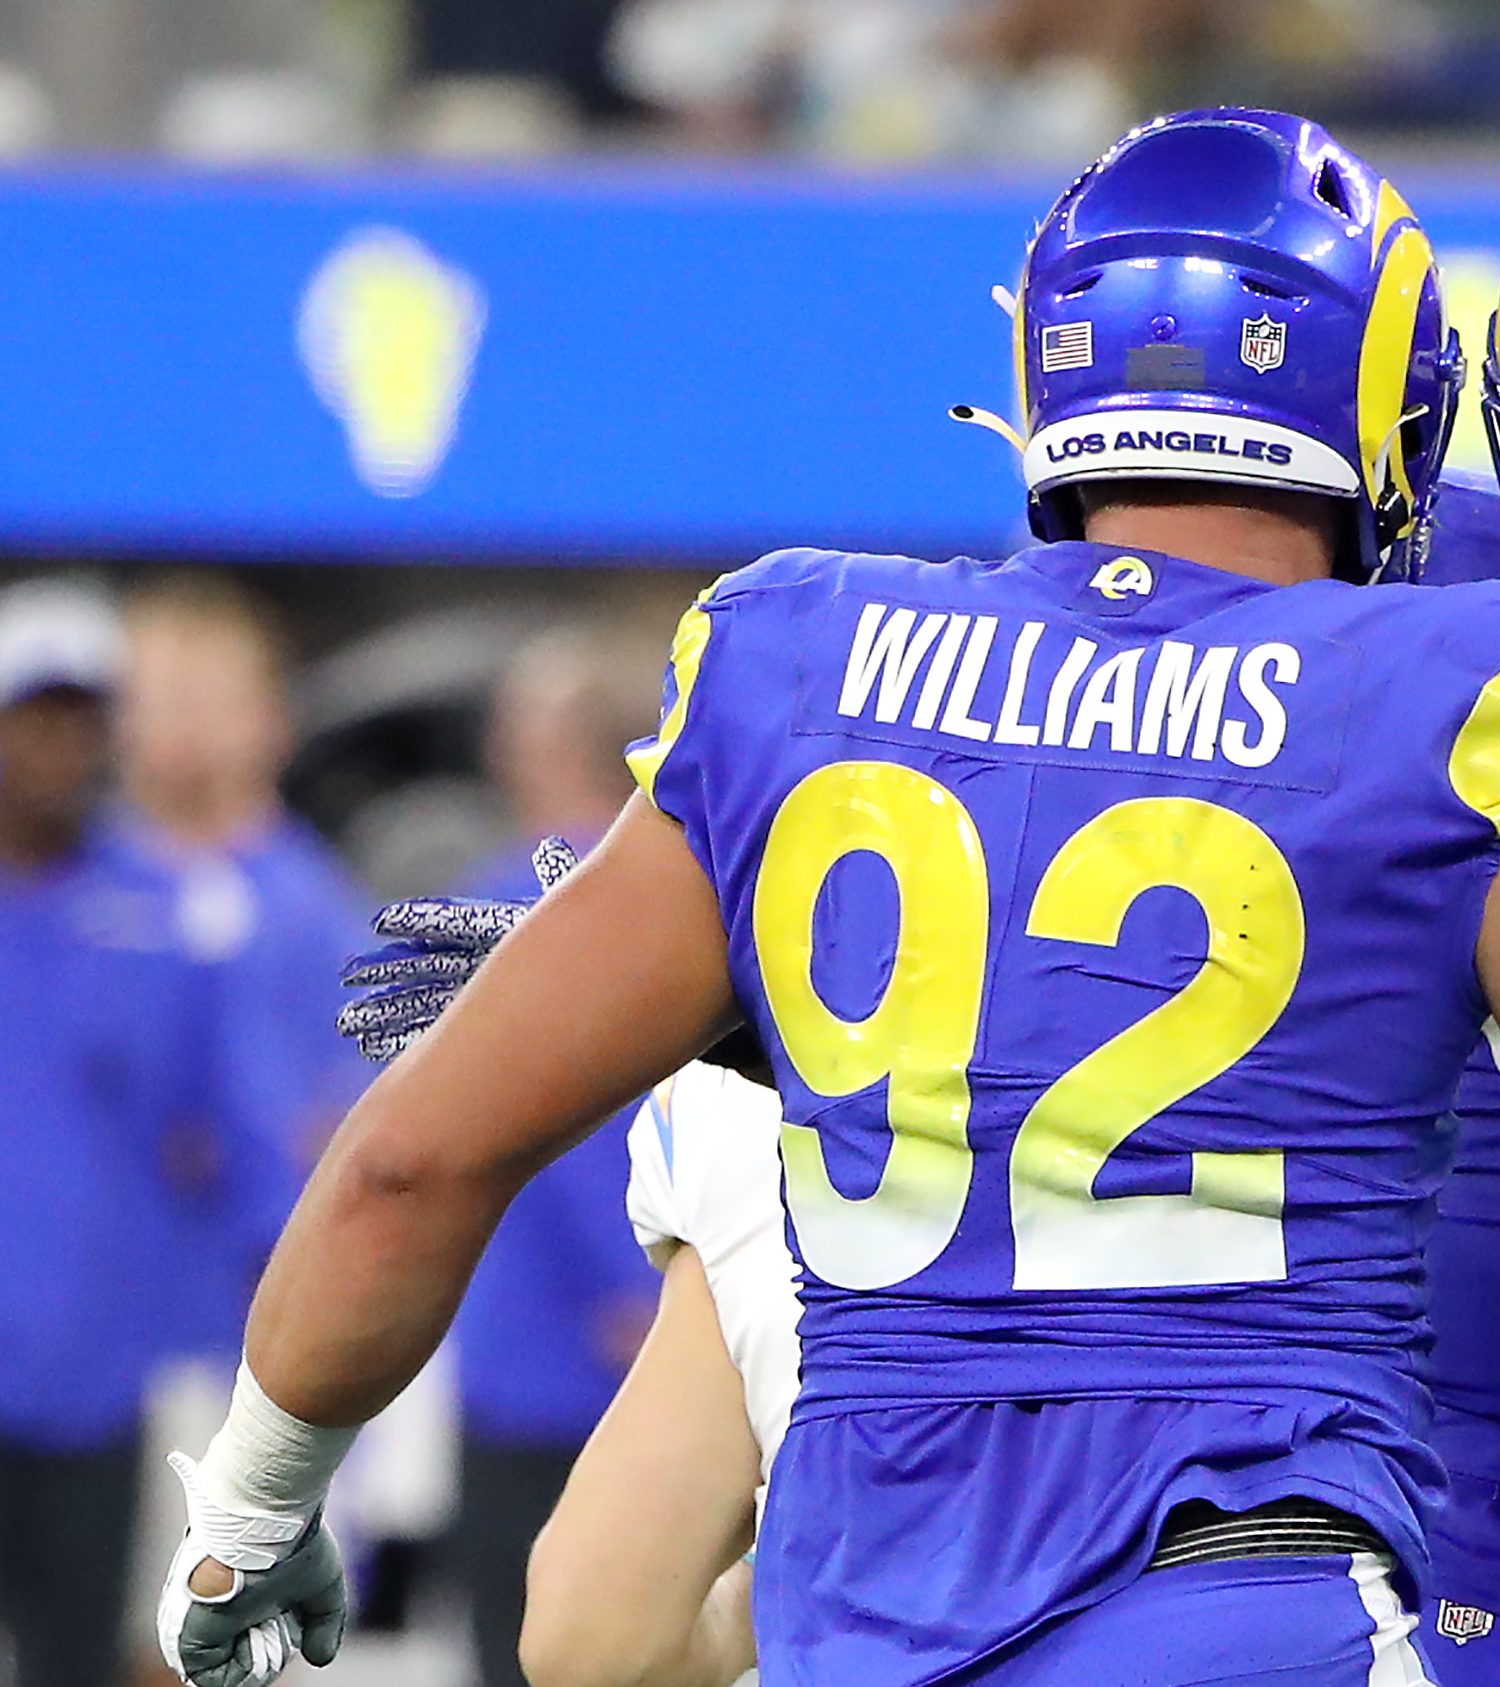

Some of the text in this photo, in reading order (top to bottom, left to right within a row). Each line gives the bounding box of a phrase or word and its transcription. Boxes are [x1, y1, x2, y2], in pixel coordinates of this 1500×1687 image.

[1248, 340, 1277, 362] NFL
[1046, 431, 1293, 465] LOS ANGELES
[837, 603, 1302, 768] WILLIAMS
[752, 761, 1306, 1291] 92
[1447, 1609, 1482, 1632] NFL
